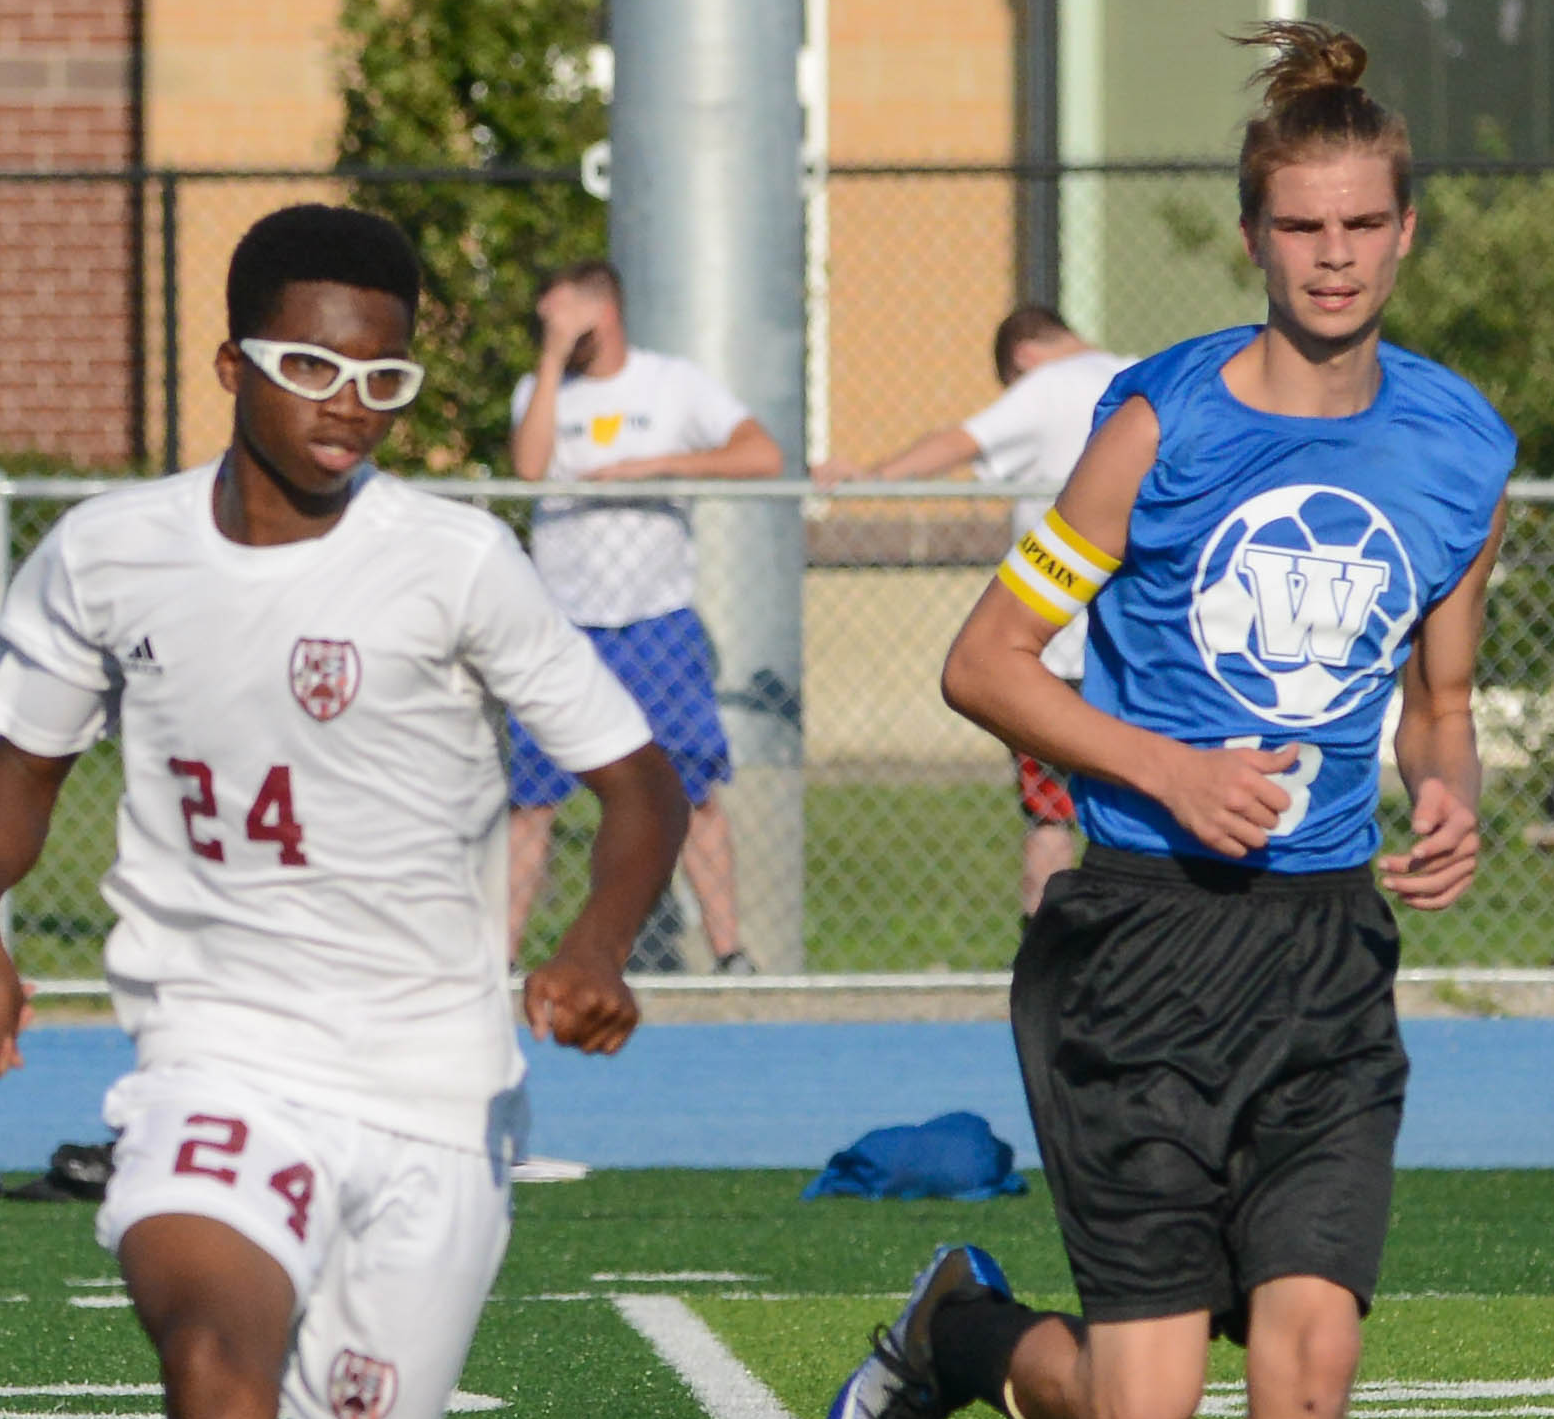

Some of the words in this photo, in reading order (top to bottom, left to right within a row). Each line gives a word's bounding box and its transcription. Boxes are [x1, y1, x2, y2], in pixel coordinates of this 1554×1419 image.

[1239, 543, 1390, 667] W
[168, 756, 308, 867] 24
[173, 1114, 316, 1243] 24
